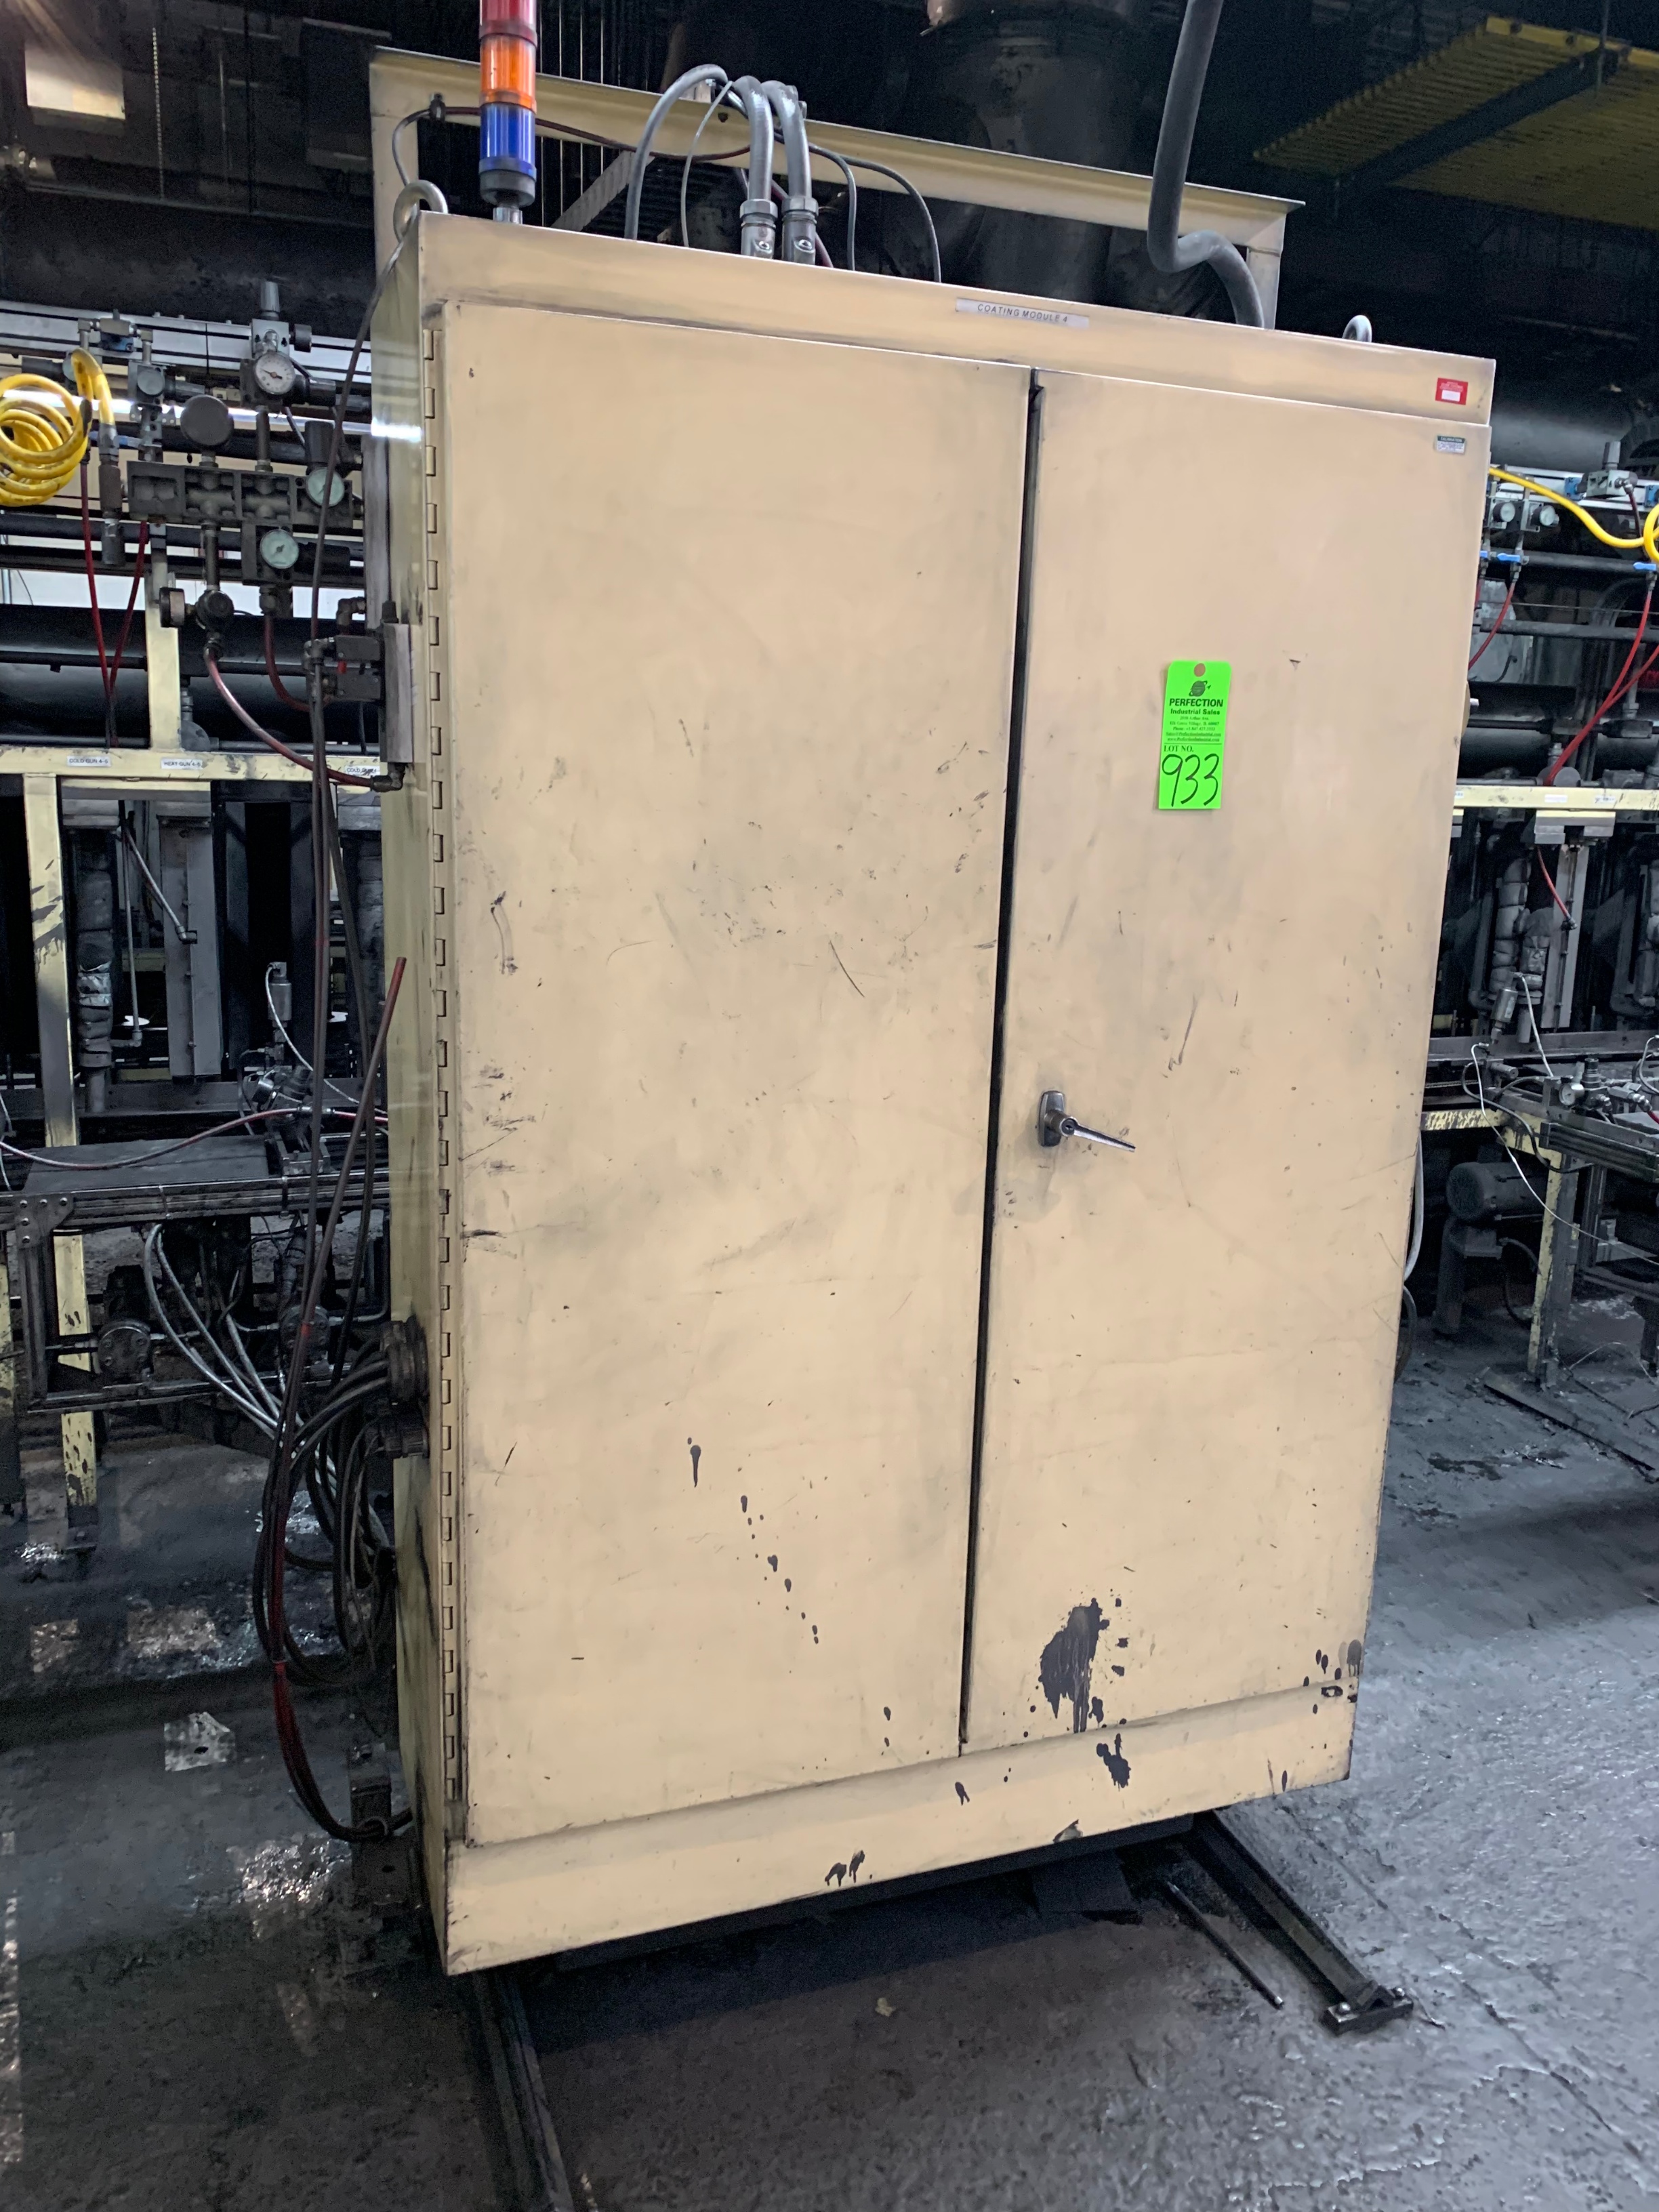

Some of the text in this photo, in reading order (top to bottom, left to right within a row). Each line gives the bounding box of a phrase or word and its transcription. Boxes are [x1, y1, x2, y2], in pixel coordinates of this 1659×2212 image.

[977, 304, 1019, 316] COATING
[1022, 310, 1061, 323] MODULE
[1169, 698, 1224, 707] PERFECTION
[1162, 753, 1219, 807] 933
